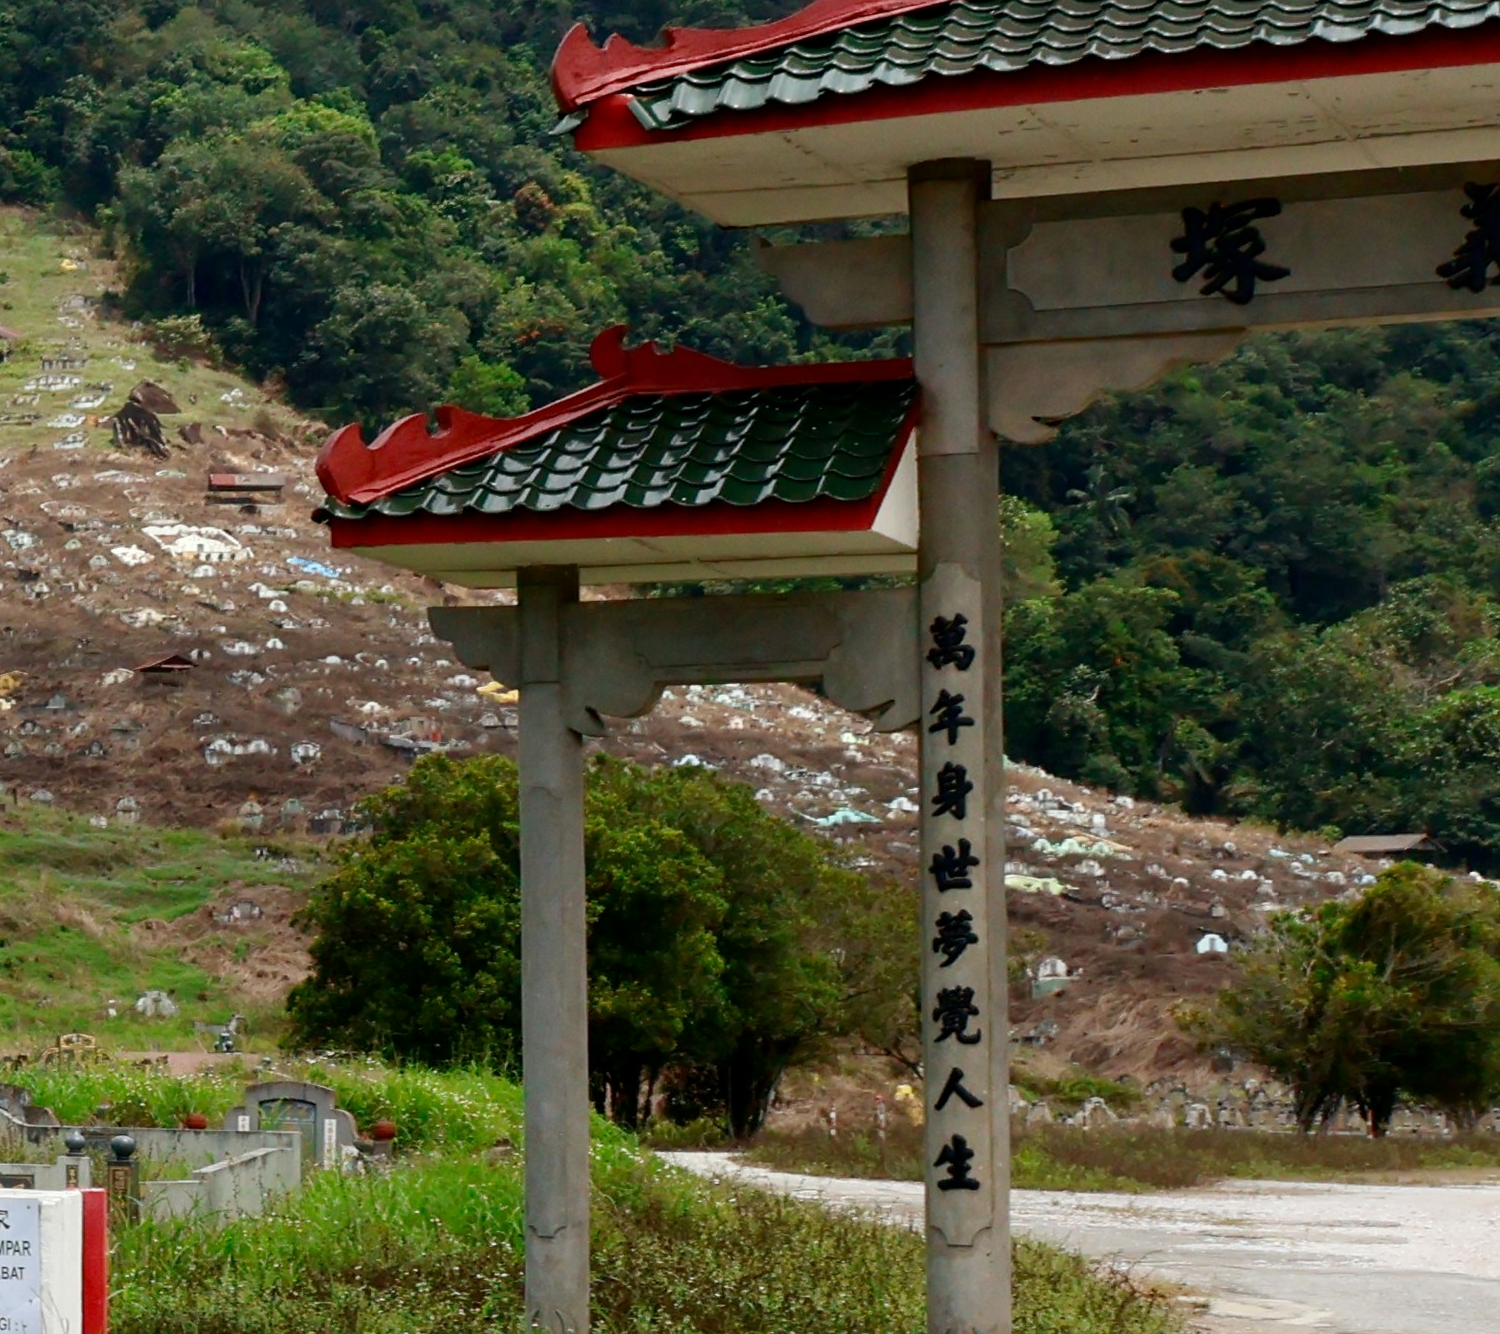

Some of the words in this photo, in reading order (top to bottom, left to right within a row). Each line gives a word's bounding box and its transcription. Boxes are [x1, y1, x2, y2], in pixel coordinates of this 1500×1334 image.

[926, 612, 985, 1192] 萬年身世夢覺人生
